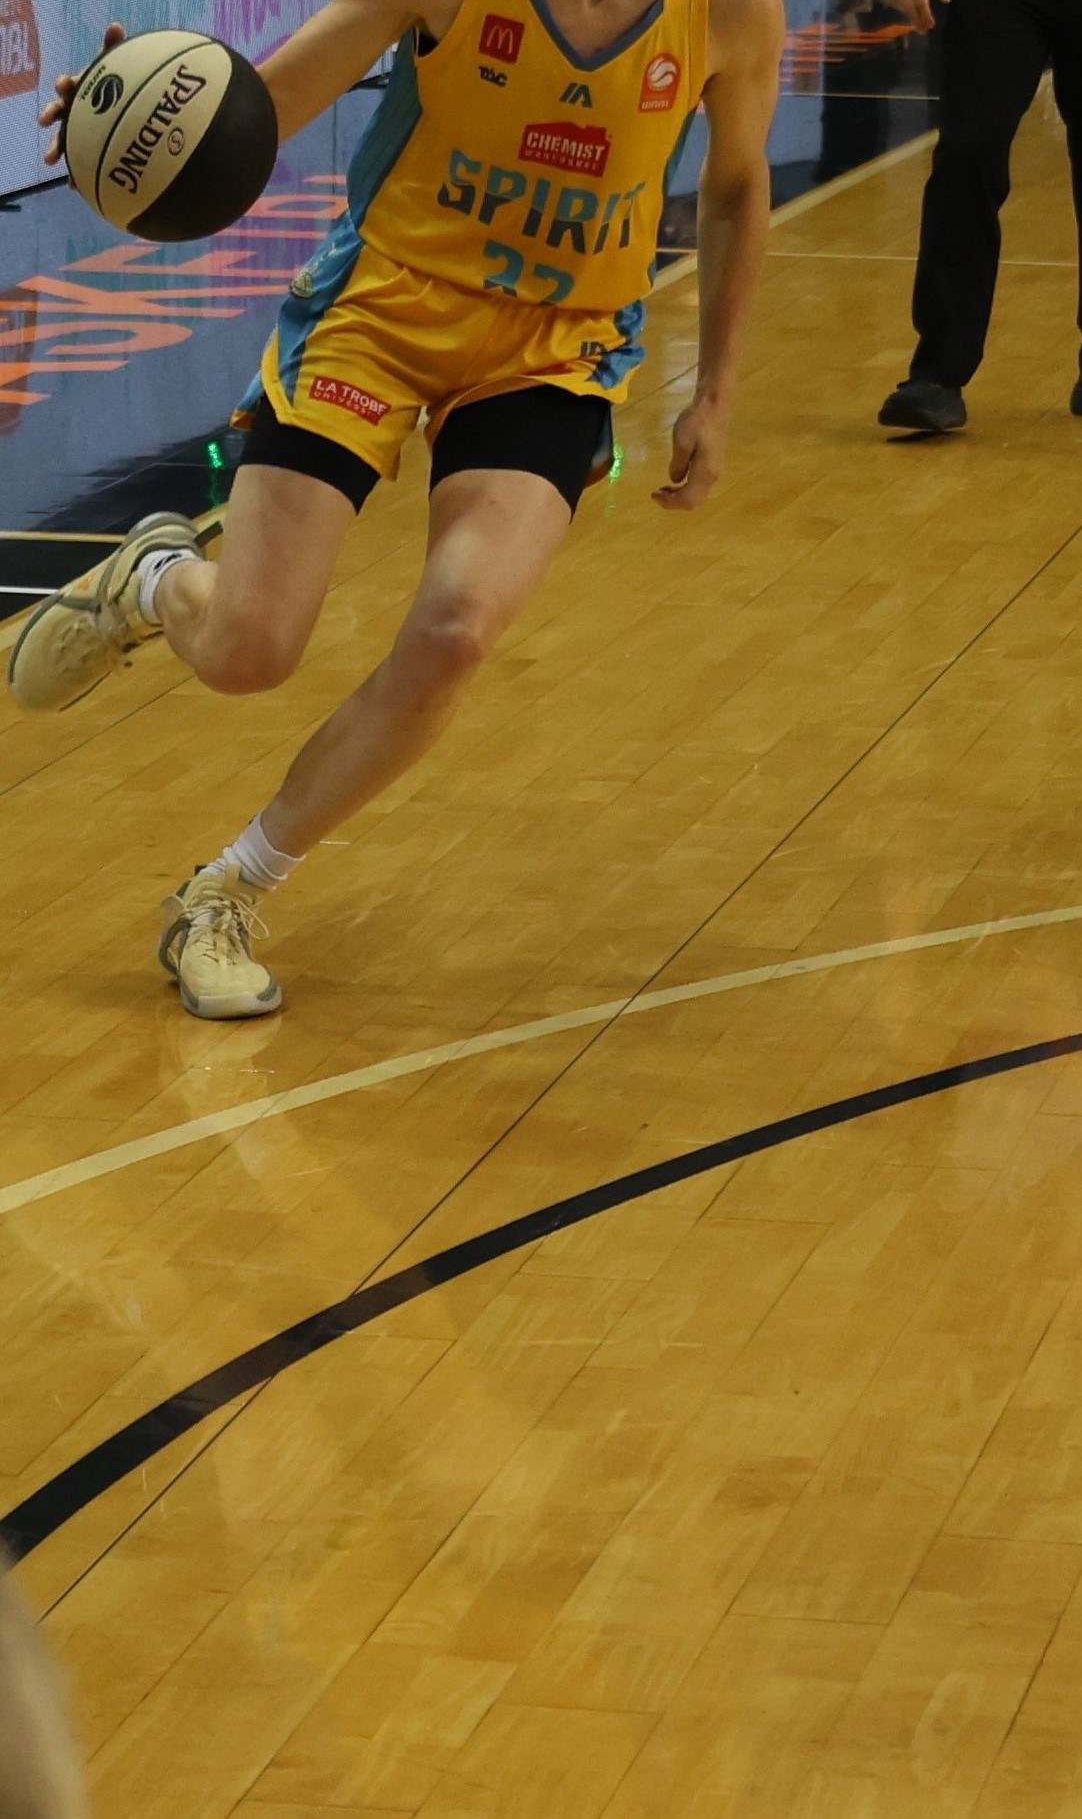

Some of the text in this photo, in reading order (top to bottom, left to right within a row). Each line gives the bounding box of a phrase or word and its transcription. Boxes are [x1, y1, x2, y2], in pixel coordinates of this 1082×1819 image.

[108, 64, 207, 195] SPALDING
[526, 131, 606, 163] CHEMIST
[315, 380, 389, 416] LA TROBE
